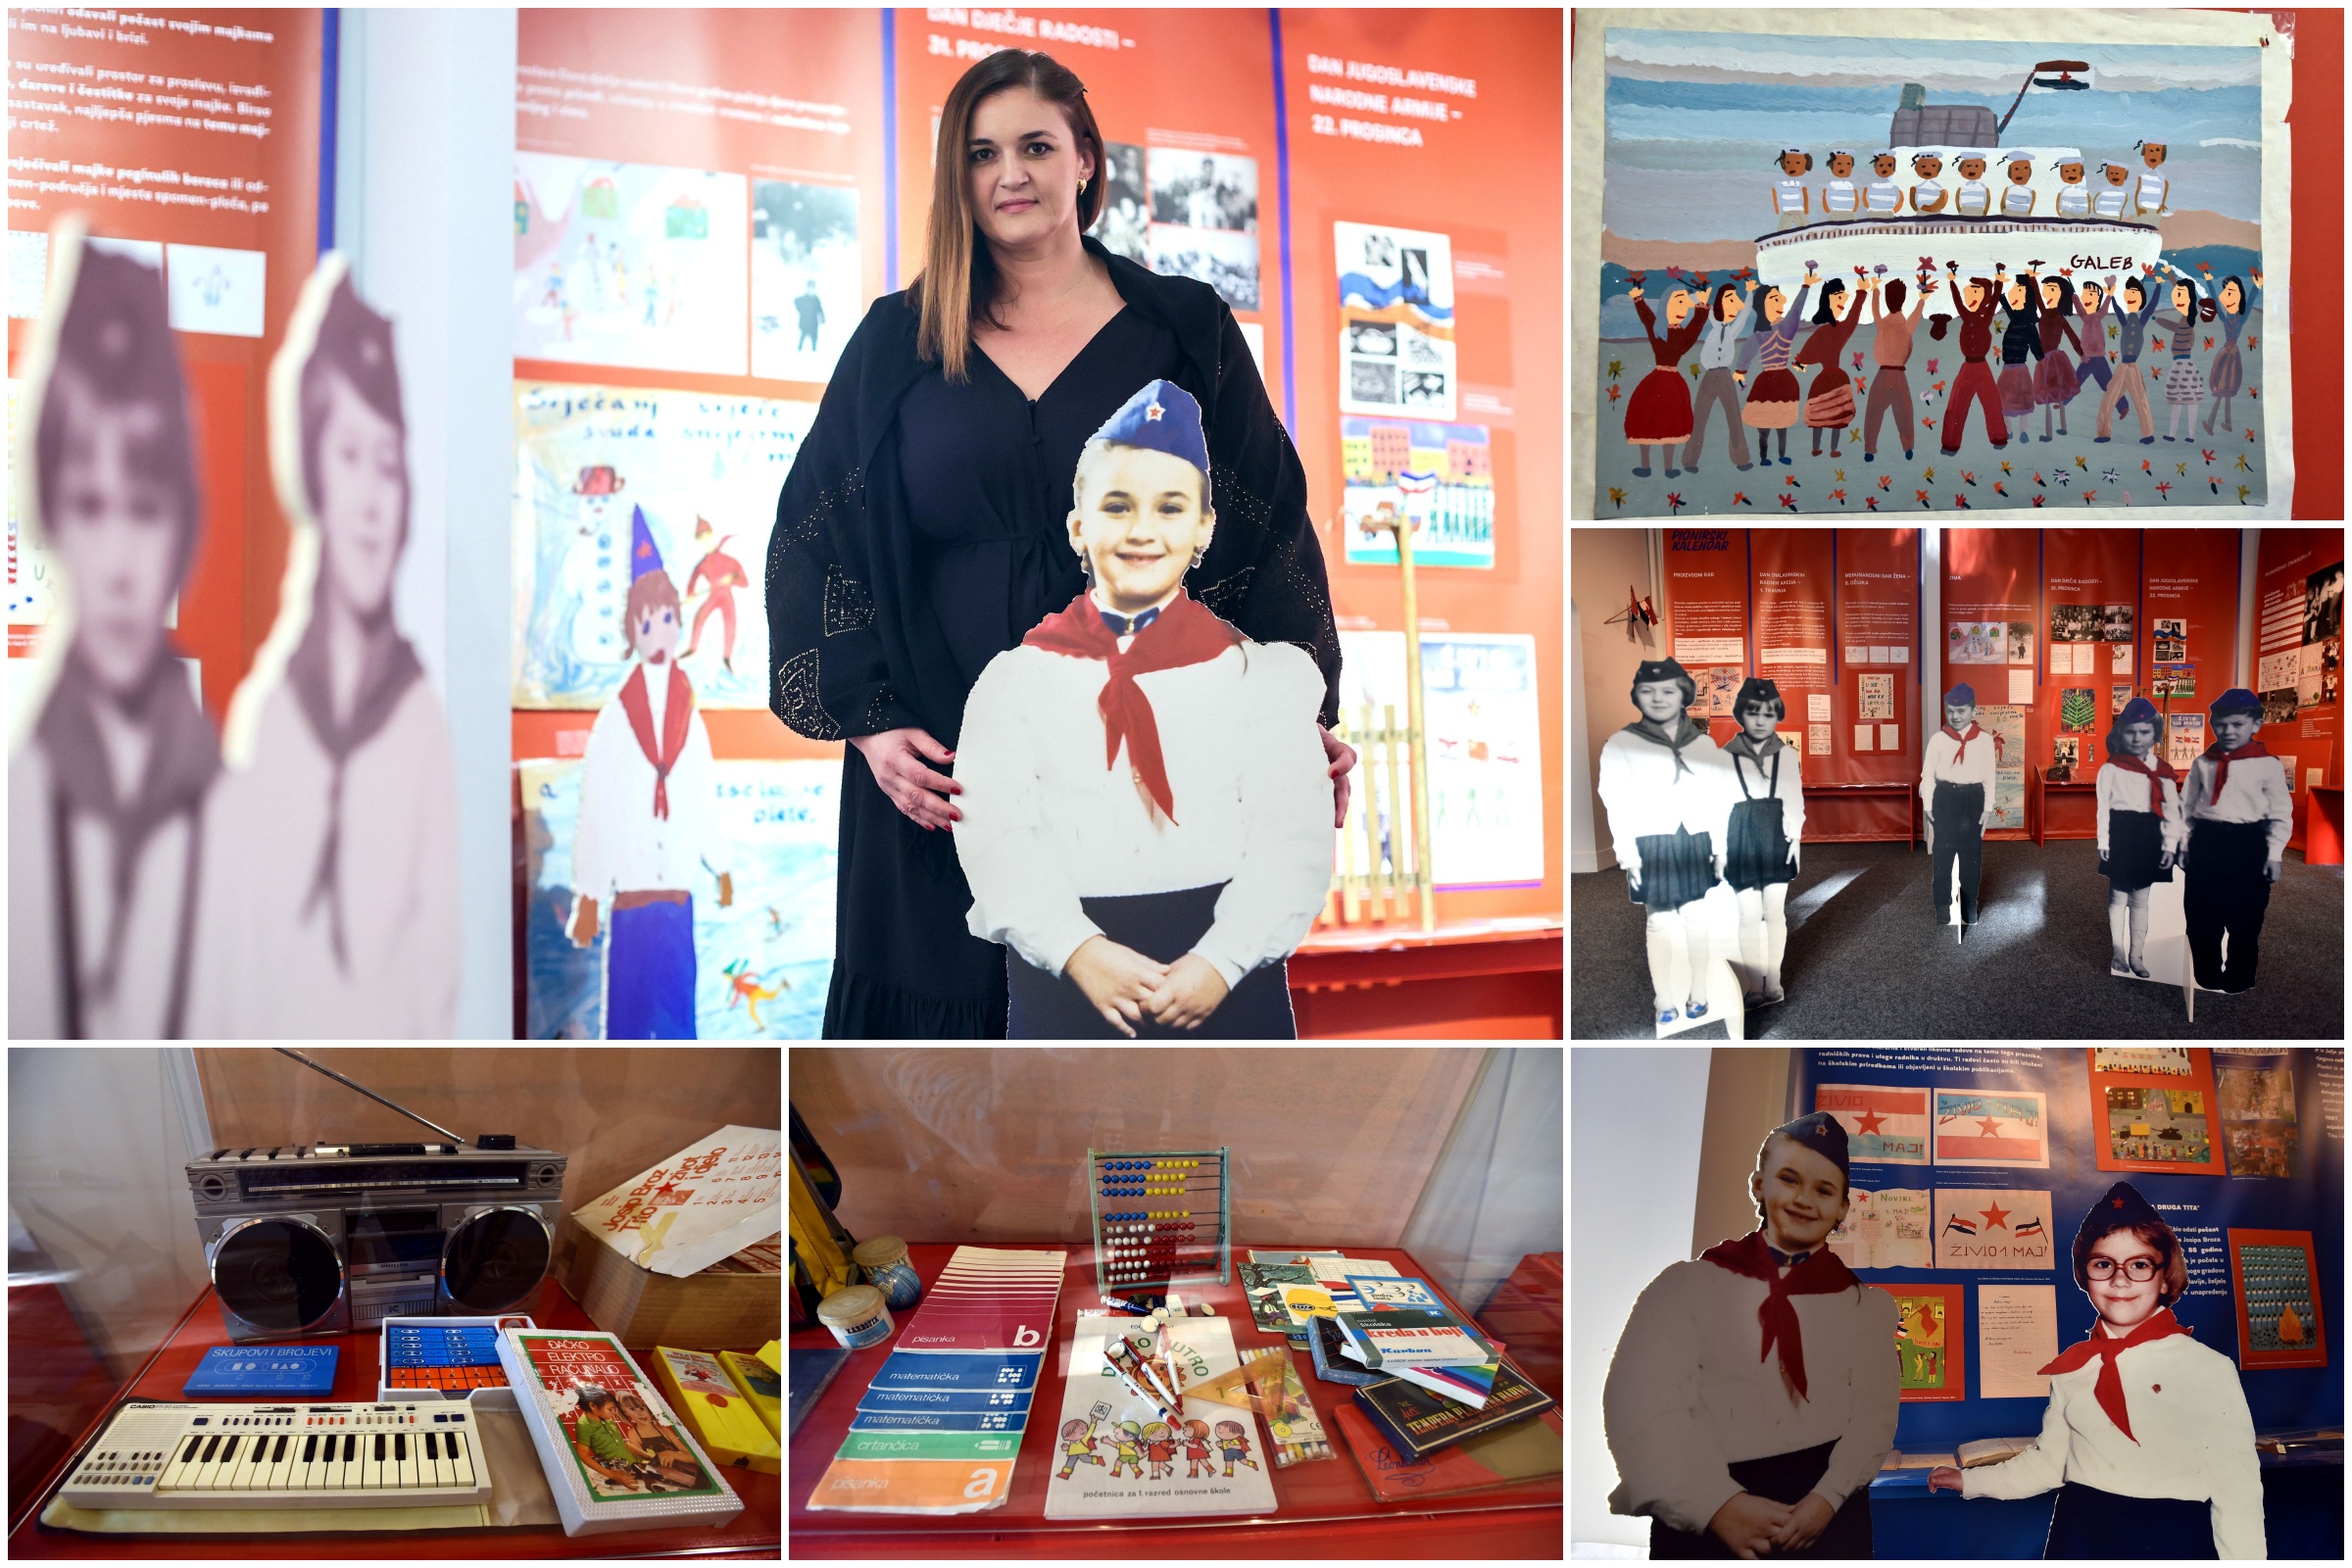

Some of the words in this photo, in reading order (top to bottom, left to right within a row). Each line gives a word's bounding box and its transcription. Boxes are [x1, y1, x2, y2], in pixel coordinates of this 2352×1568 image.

[1039, 22, 1119, 50] RADOSTI
[1307, 53, 1344, 77] DAN
[1345, 60, 1477, 99] JUGOSLAVENSKE
[1309, 83, 1389, 114] NARODNE
[1391, 96, 1448, 123] ARMIJE
[1340, 118, 1424, 149] PROSINCA
[2070, 254, 2133, 270] GALEB
[1672, 530, 1728, 540] PIONIRSKI
[1672, 541, 1730, 551] KALENDAR
[2020, 1059, 2043, 1068] izloženi
[1938, 1098, 1983, 1126] ŽIVIO
[1883, 1142, 1924, 1156] MAJ!
[669, 1155, 703, 1181] život
[695, 1147, 728, 1175] djelo
[630, 1168, 669, 1197] Broz
[602, 1198, 643, 1232] Josip
[618, 1206, 658, 1233] Tito
[2013, 1246, 2047, 1258] MAJ!
[845, 1315, 880, 1335] KARBOFIX
[1364, 1326, 1415, 1338] kreda
[1427, 1326, 1464, 1338] boji
[911, 1335, 956, 1345] pisanka
[1012, 1325, 1041, 1347] b
[548, 1340, 590, 1349] ĐAČKO
[212, 1348, 269, 1357] SKUPOVI
[277, 1348, 332, 1357] BROJEVI
[547, 1352, 606, 1361] ELEKTRO
[549, 1363, 620, 1375] RAČUNALO
[890, 1372, 959, 1381] matematička
[876, 1393, 950, 1402] matematička
[863, 1414, 941, 1425] matematička
[1405, 1408, 1454, 1435] TEMPERA
[857, 1439, 920, 1450] crtančica
[830, 1476, 890, 1491] pisanka
[962, 1467, 999, 1499] a
